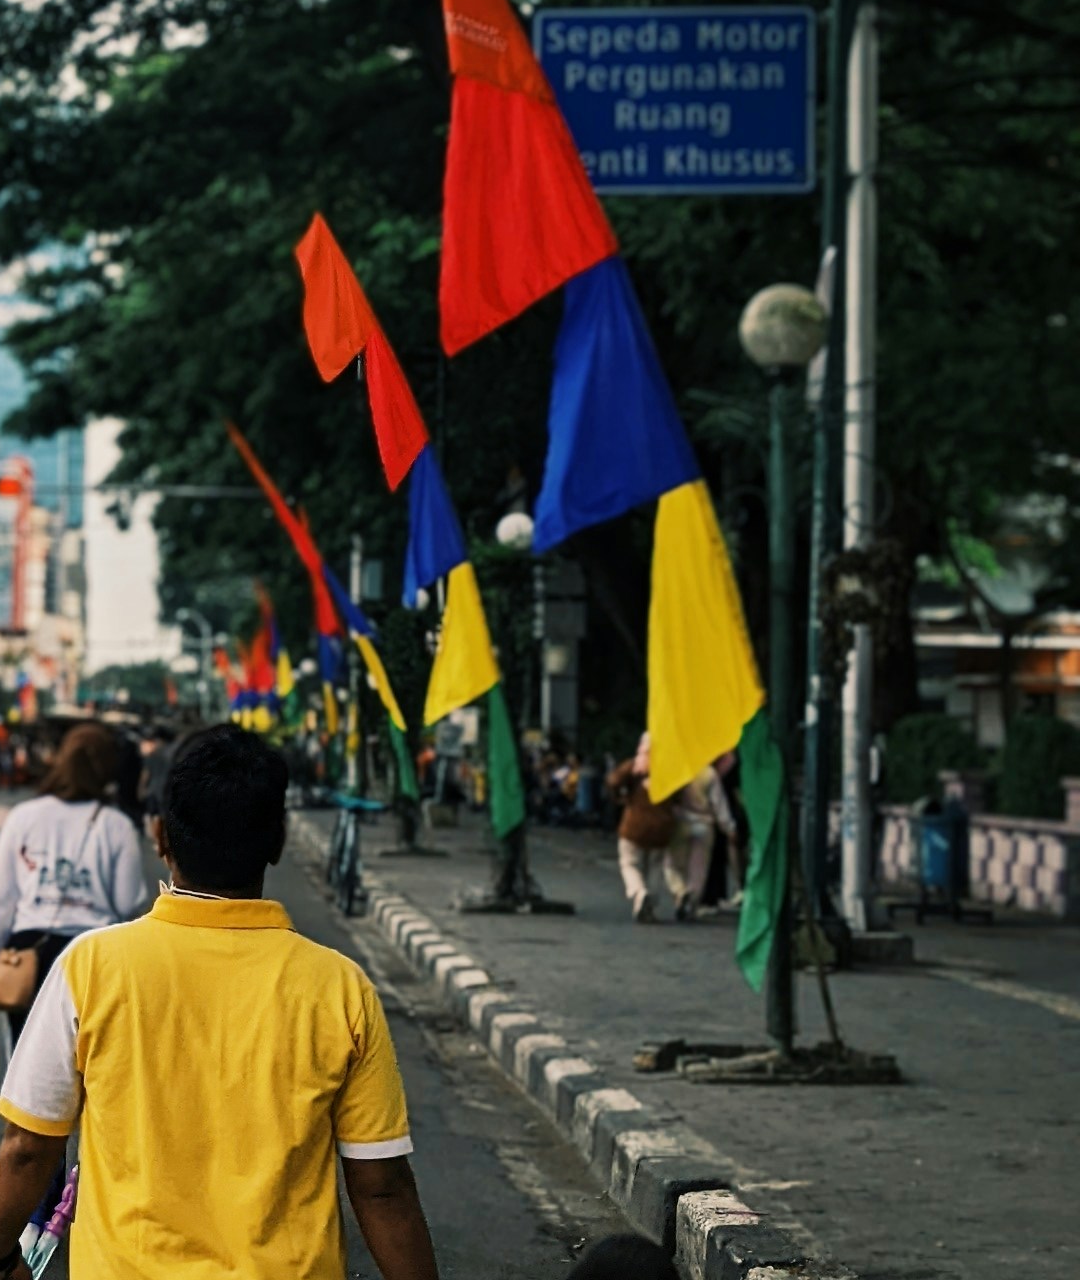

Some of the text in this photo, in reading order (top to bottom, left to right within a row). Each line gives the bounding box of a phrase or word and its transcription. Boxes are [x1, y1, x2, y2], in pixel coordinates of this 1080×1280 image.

[546, 21, 680, 58] Sepeda
[697, 20, 802, 52] Motor
[564, 60, 784, 98] Pergunakan
[614, 101, 731, 138] Ruang
[580, 143, 795, 177] enti Khusus
